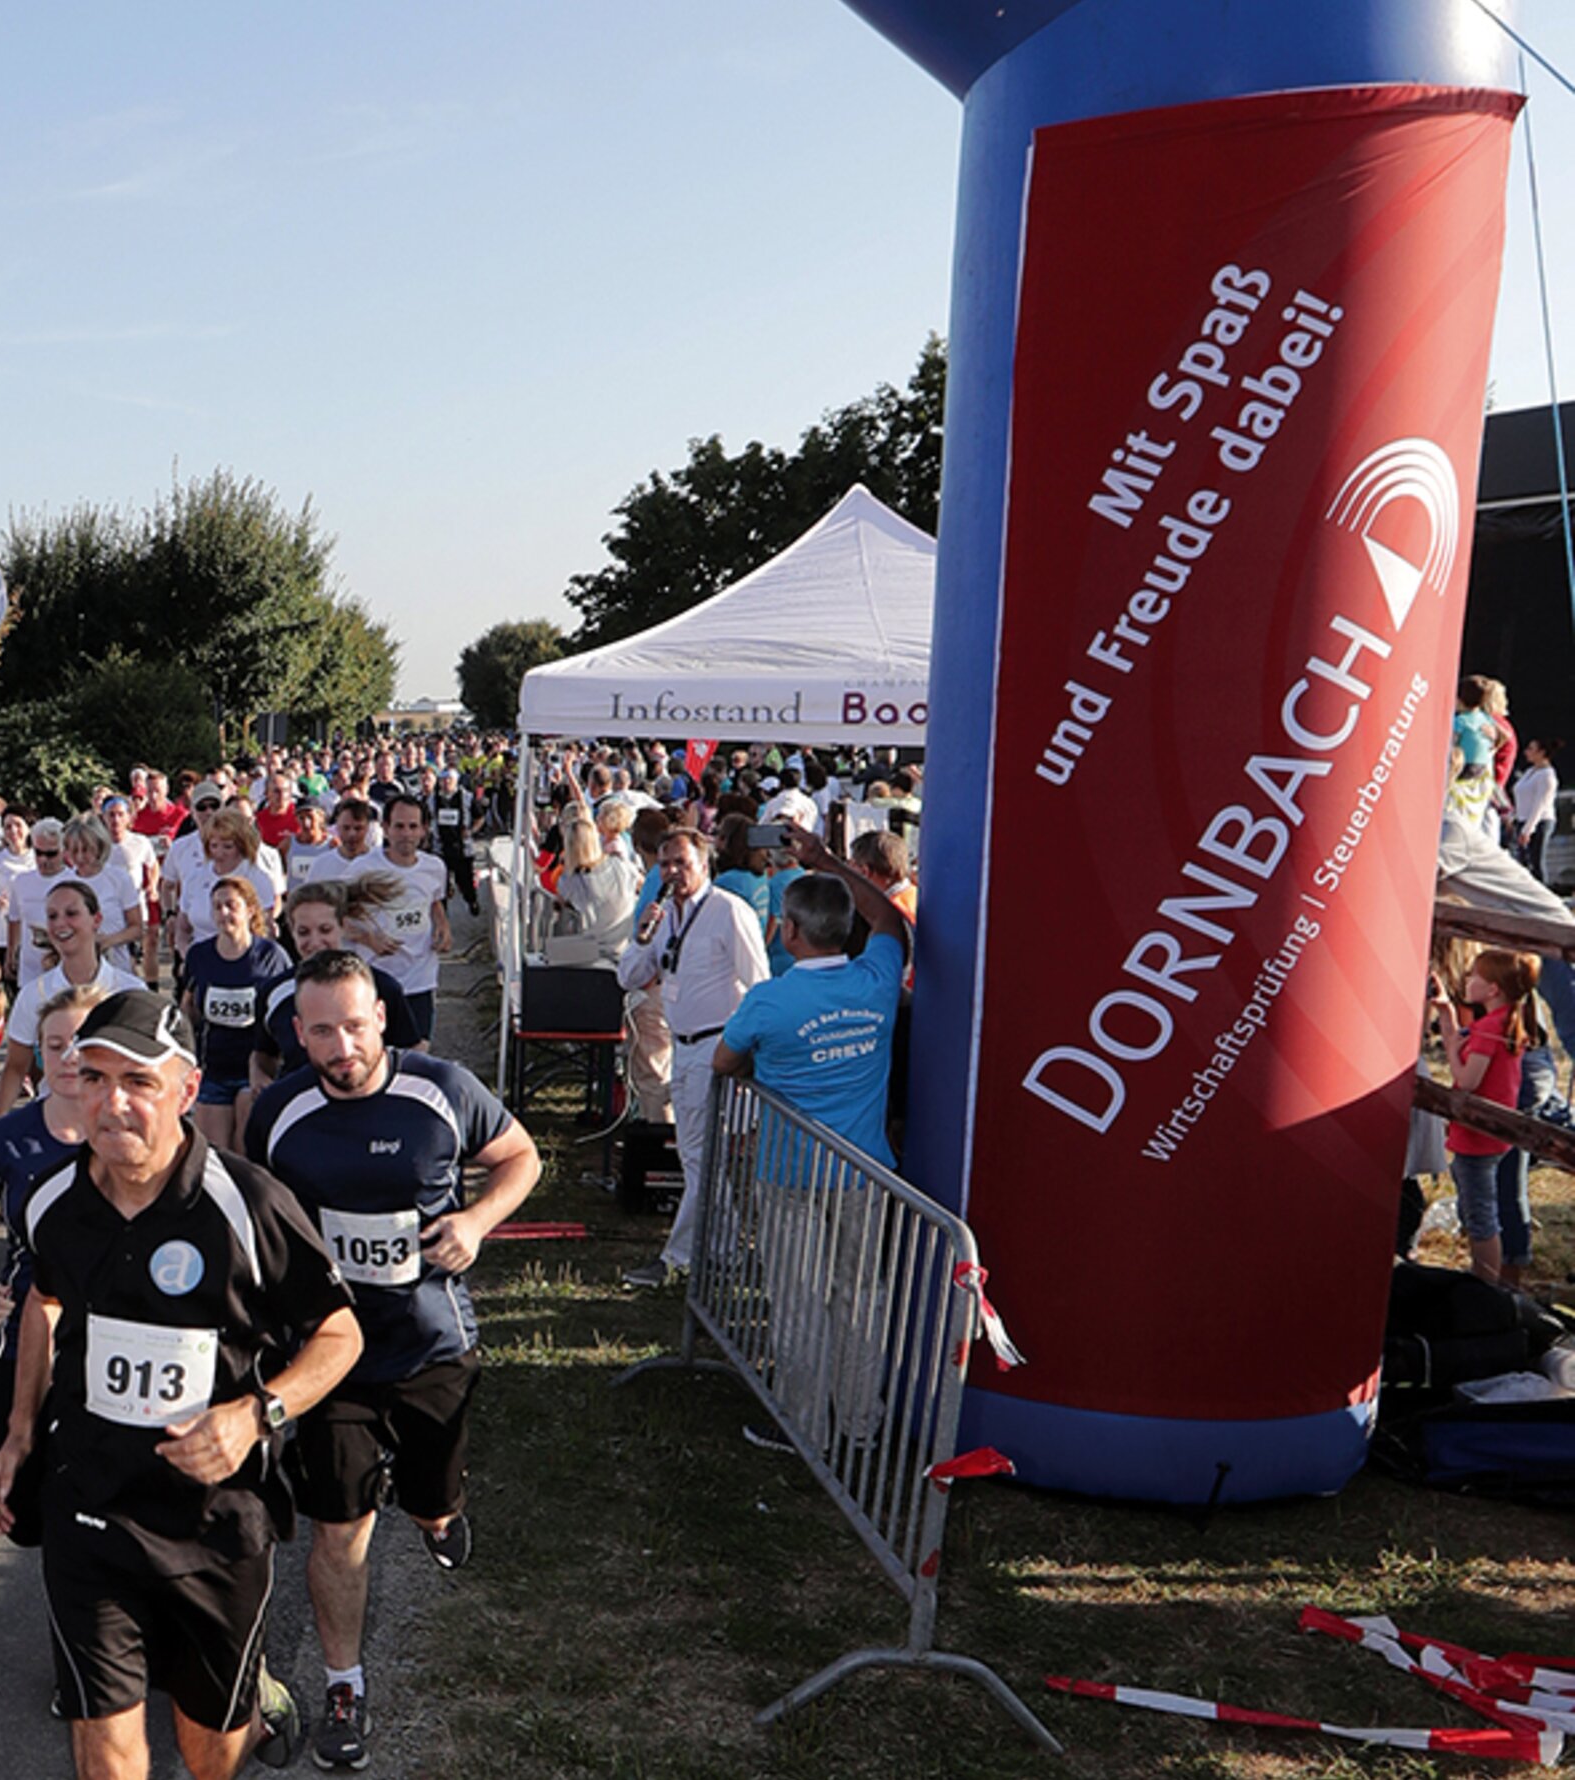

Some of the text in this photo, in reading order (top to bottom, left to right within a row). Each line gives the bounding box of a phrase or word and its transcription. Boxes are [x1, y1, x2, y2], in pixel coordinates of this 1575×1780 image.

[1088, 262, 1272, 530] Mit Spaß
[1034, 288, 1345, 787] und Freude dabei!
[609, 690, 803, 724] Infostand
[1021, 613, 1393, 1136] DORNBACH
[395, 910, 422, 928] 592
[1140, 913, 1322, 1164] Wirtschaftsprüfung
[1312, 670, 1430, 894] Steuerberatung
[208, 1000, 251, 1018] 5294
[811, 1039, 878, 1063] CREW
[331, 1234, 410, 1267] 1053
[106, 1354, 187, 1402] 913
